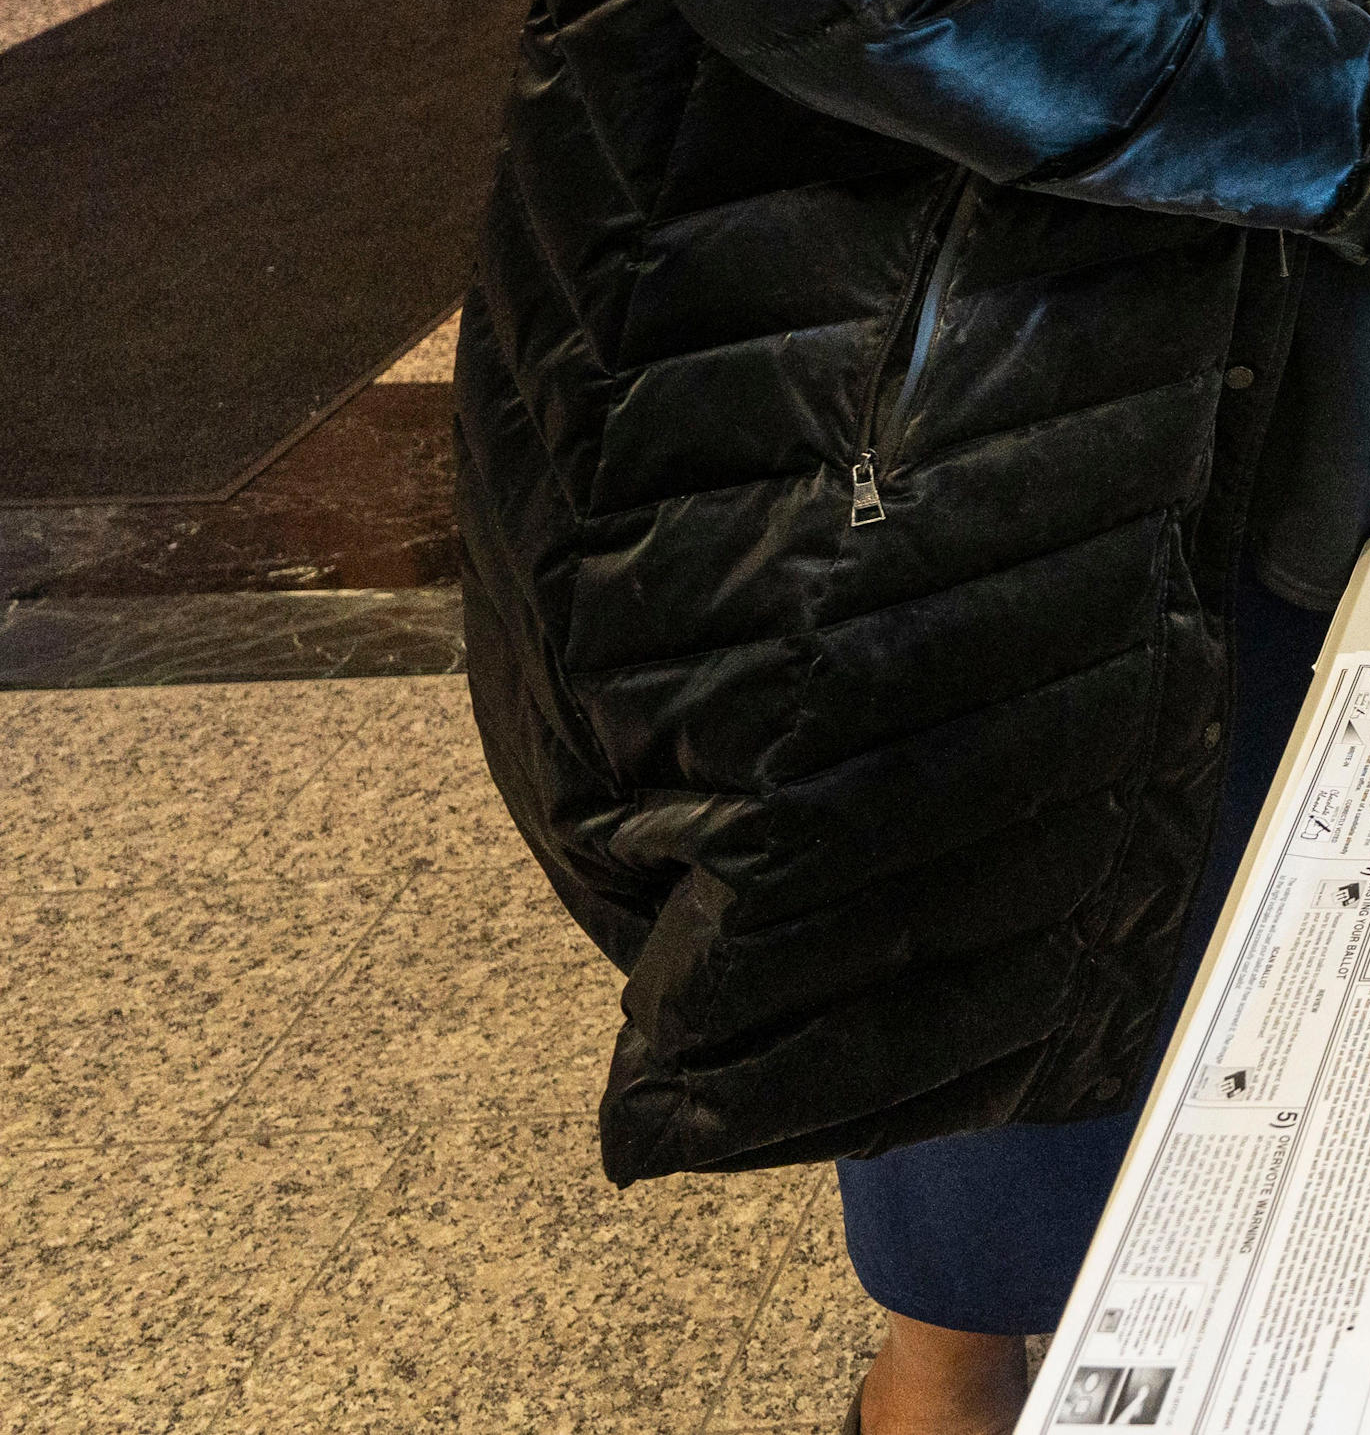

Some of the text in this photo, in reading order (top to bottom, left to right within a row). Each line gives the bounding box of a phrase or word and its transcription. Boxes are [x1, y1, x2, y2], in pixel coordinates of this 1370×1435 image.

[1331, 798, 1354, 843] CORRECTLY VOTED
[1351, 918, 1367, 943] YOUR
[1258, 946, 1281, 989] SCAN BALLOT
[1336, 945, 1357, 980] BALLOT
[1311, 989, 1325, 1013] REVIEW
[1239, 1111, 1297, 1254] 5) OVERVOTE WARNING
